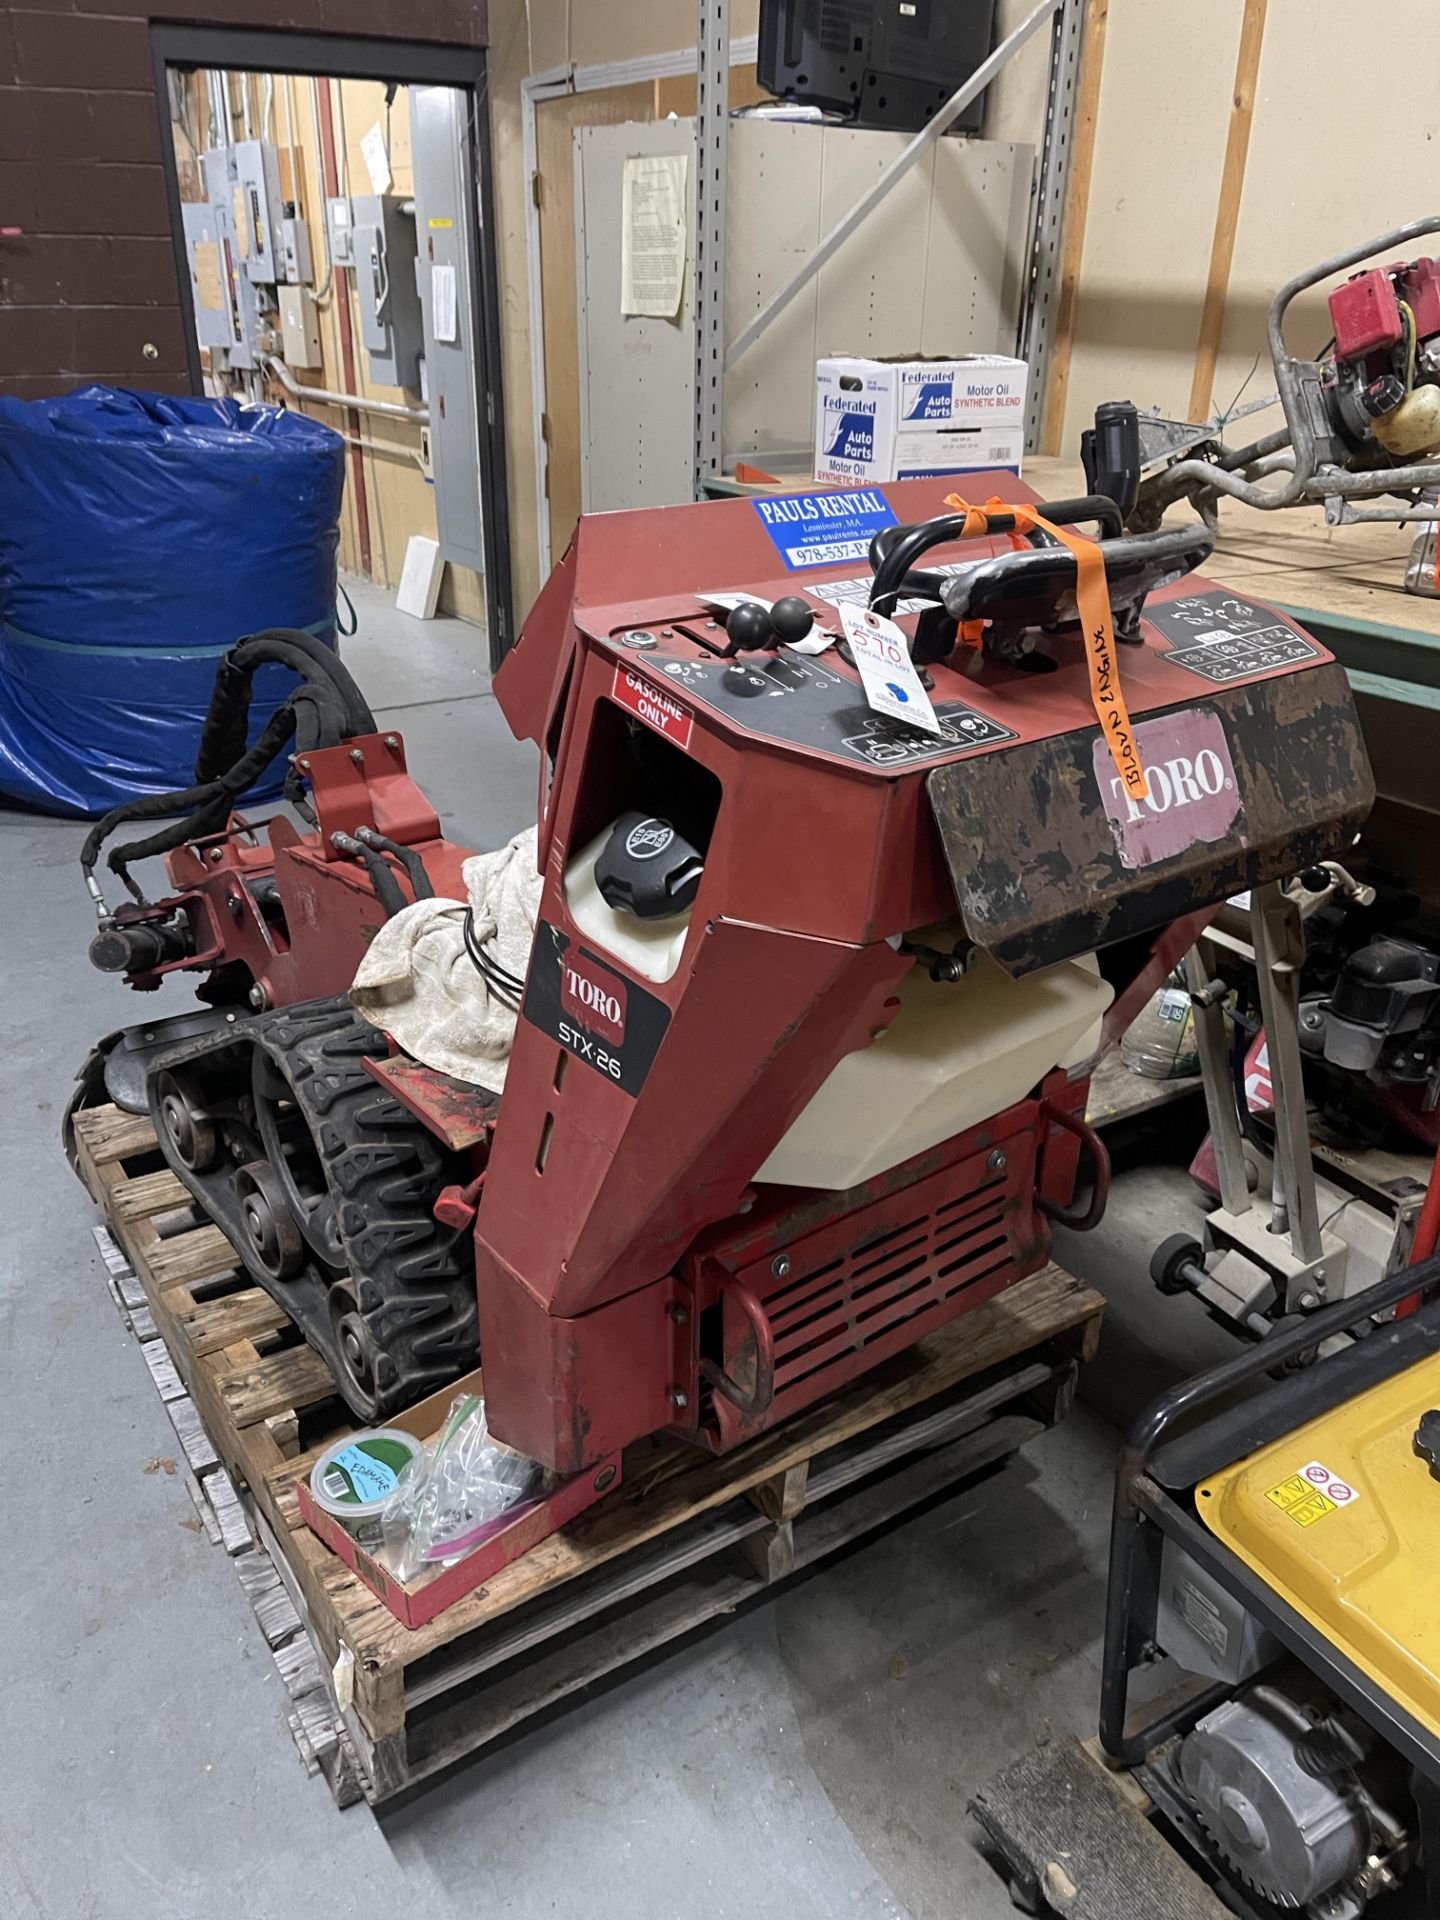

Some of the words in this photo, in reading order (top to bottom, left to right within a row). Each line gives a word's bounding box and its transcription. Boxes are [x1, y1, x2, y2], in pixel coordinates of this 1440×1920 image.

[902, 371, 954, 382] Federated
[967, 385, 993, 396] Motor
[996, 384, 1009, 395] Oil
[824, 395, 876, 414] Federated
[928, 396, 951, 406] Auto
[954, 398, 994, 408] SYNTHETIC
[996, 396, 1021, 407] BLEND
[924, 407, 951, 417] Parts
[847, 430, 872, 445] Auto
[844, 444, 872, 459] Parts
[830, 459, 851, 473] Motor
[853, 463, 865, 477] Oil
[817, 470, 853, 486] SYNTHETIC
[758, 498, 819, 524] PAULS
[815, 492, 886, 517] RENTAL
[852, 629, 902, 663] 570
[626, 672, 684, 722] GASOLINE
[637, 699, 669, 729] ONLY
[1109, 749, 1225, 823] TORO
[567, 968, 622, 1024] TORO
